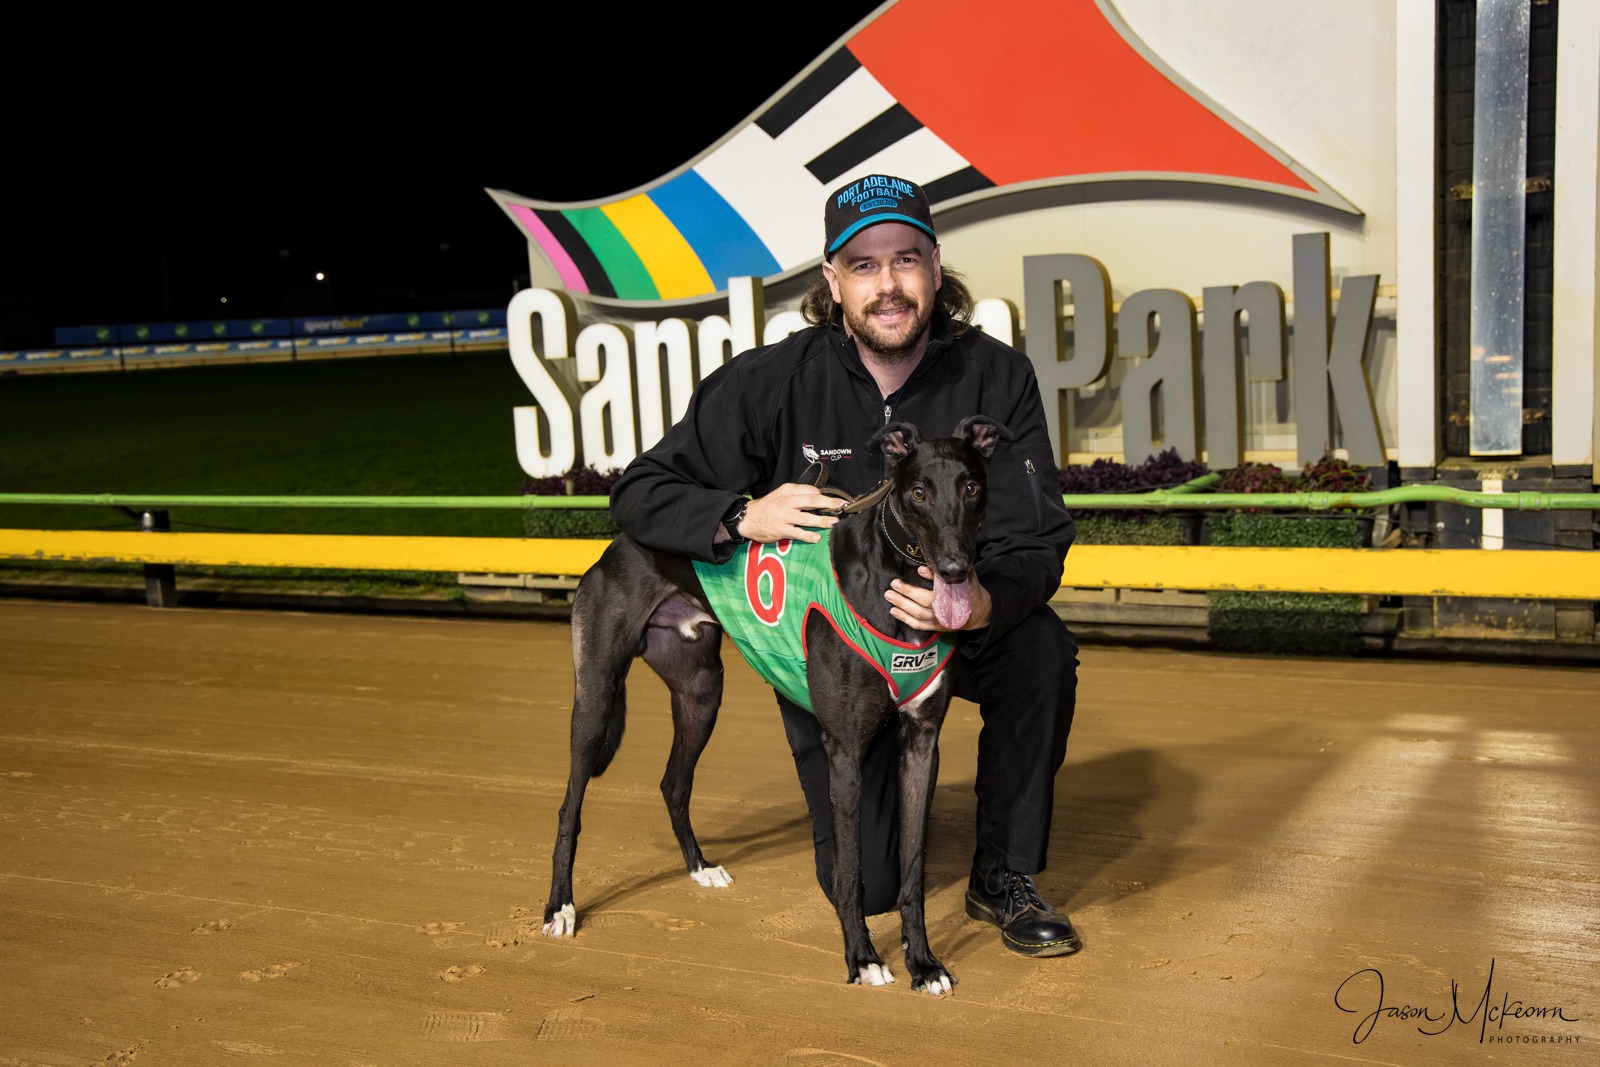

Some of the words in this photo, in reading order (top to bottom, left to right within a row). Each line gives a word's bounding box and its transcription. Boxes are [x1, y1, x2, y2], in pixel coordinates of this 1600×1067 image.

[837, 182, 860, 209] PORT
[863, 176, 915, 198] ADELAIDE
[851, 187, 903, 207] FOOTBALL
[1023, 232, 1387, 470] Park
[744, 539, 793, 627] 6
[893, 654, 925, 667] GRV
